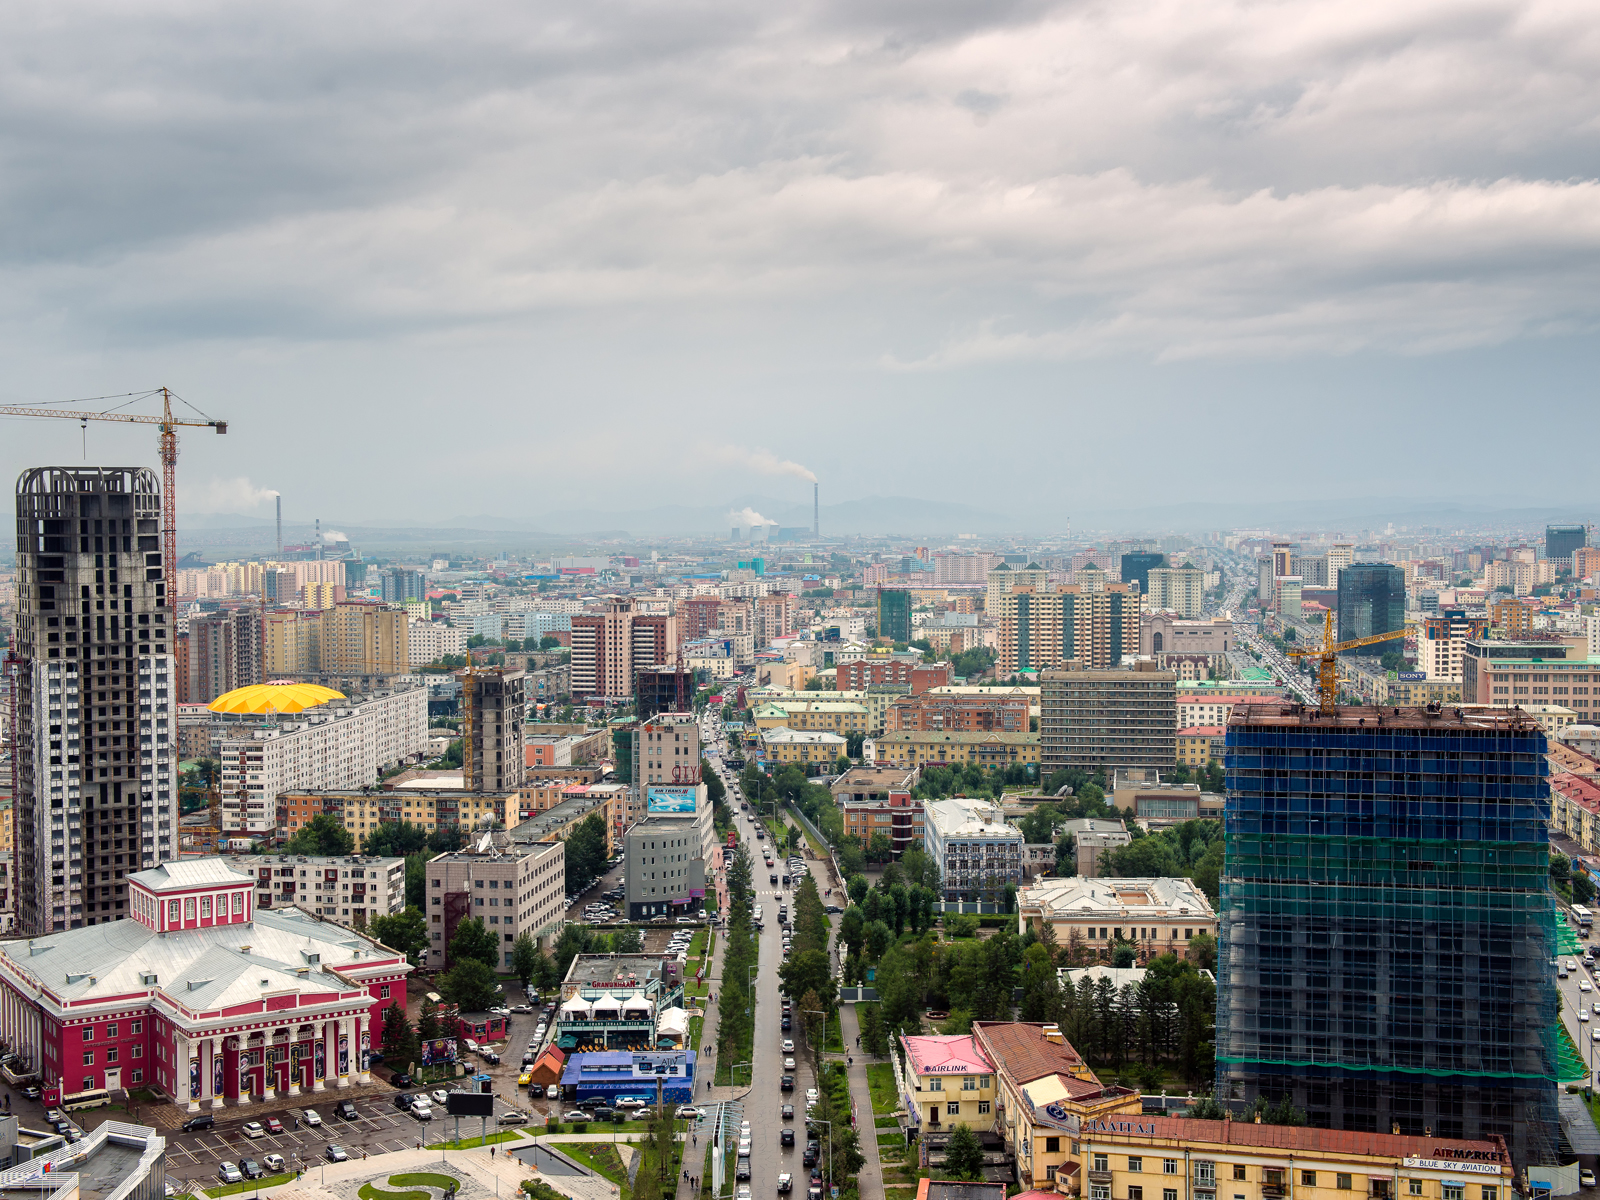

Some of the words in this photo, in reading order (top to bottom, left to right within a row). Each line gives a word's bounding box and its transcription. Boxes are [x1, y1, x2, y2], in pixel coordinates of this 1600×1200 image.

[671, 766, 697, 779] CITY
[661, 1058, 678, 1066] ATIV
[1086, 1119, 1156, 1135] ДААТГАЛ
[1432, 1147, 1505, 1161] AIRMARKET
[1419, 1160, 1439, 1168] BLUE
[1461, 1163, 1497, 1172] AVIATION
